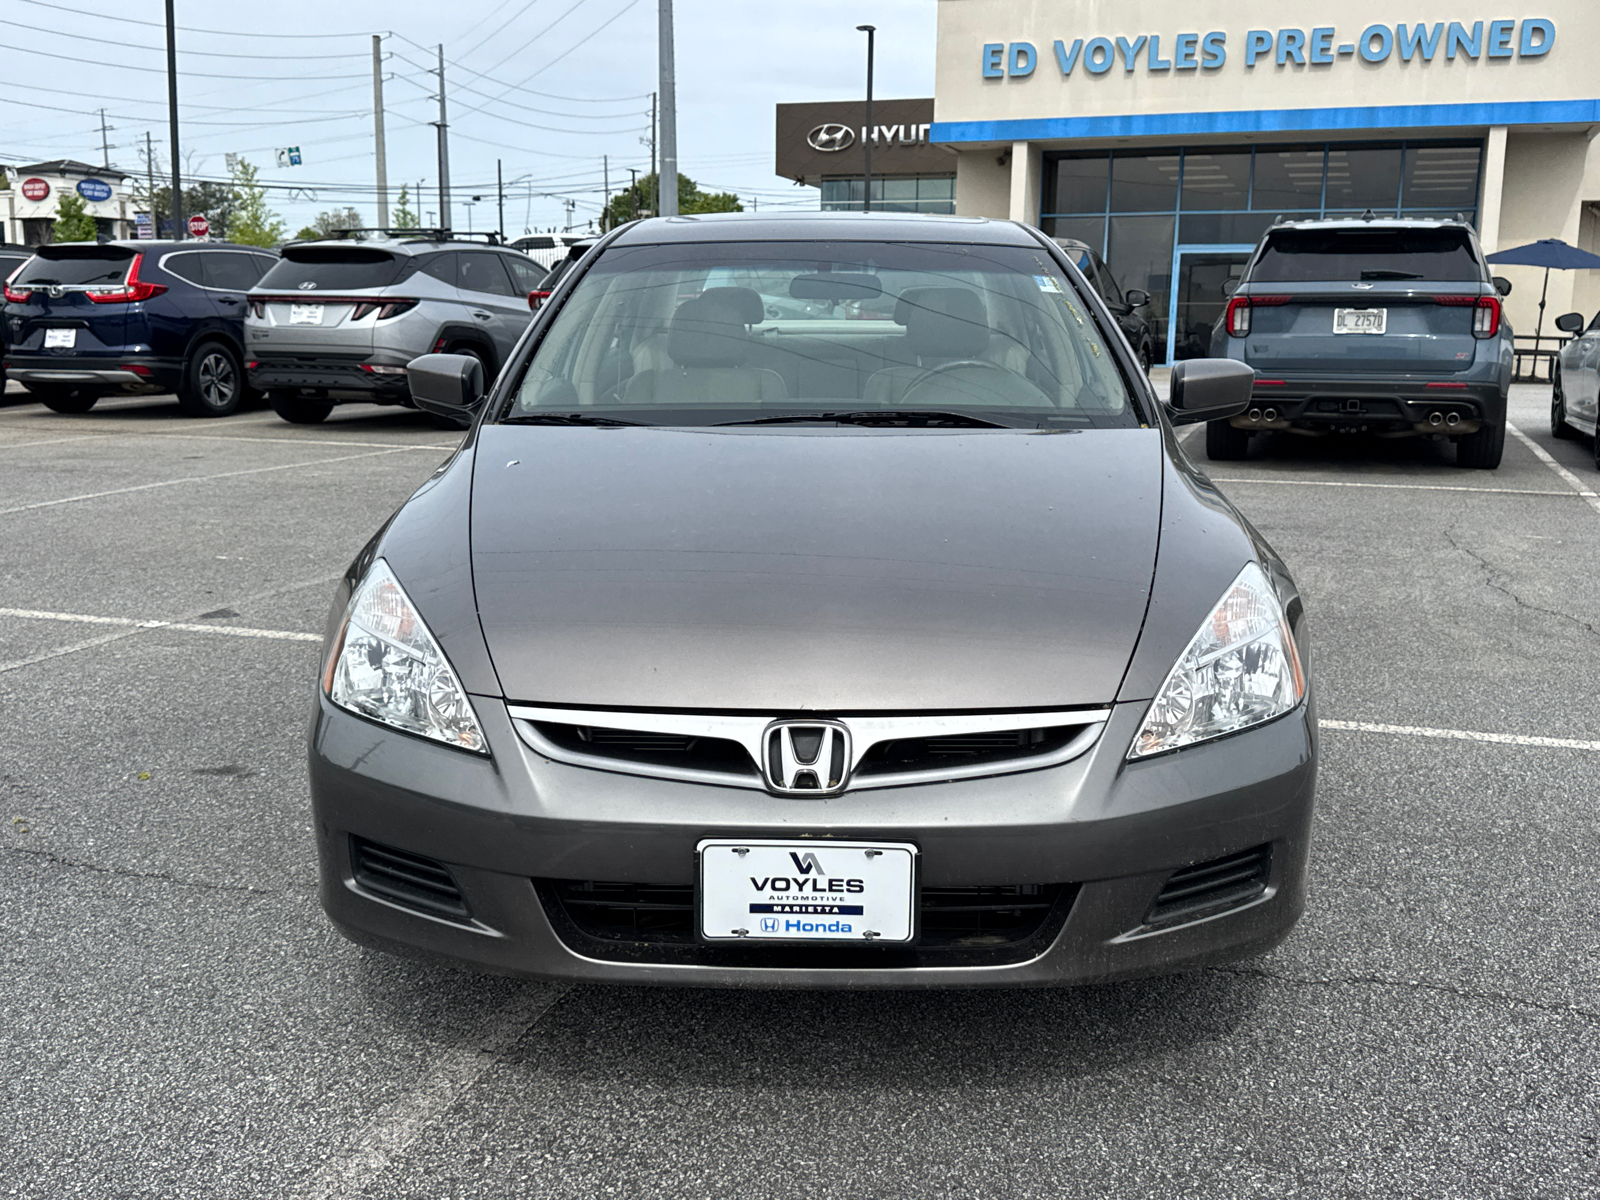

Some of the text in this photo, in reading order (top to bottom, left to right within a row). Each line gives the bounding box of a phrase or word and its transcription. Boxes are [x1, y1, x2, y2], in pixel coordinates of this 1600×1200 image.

[982, 18, 1556, 78] ED VOYLES PRE-OWNED
[189, 222, 208, 231] STOP
[1337, 315, 1347, 327] DL
[750, 877, 865, 893] VOYLES
[773, 905, 840, 913] MARIETTA
[785, 919, 852, 933] Honda
